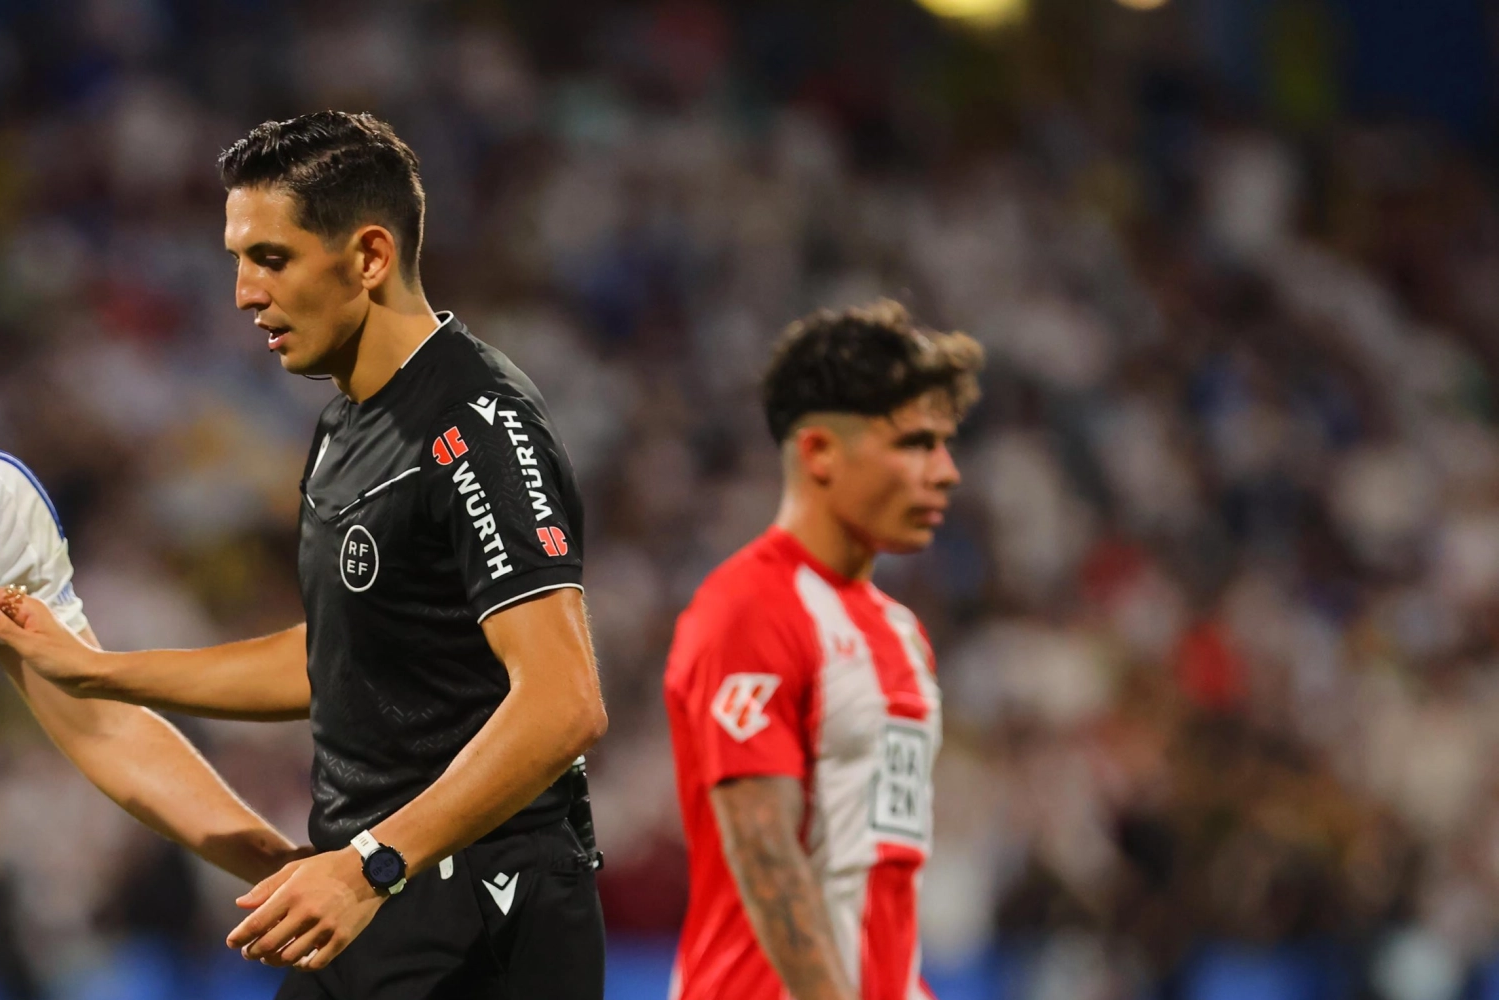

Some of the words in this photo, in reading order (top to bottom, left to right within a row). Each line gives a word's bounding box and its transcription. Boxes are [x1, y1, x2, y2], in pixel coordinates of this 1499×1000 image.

[497, 410, 552, 522] WÜRTH
[348, 540, 369, 557] RF
[452, 460, 514, 580] WÜRTH
[346, 559, 368, 576] EF
